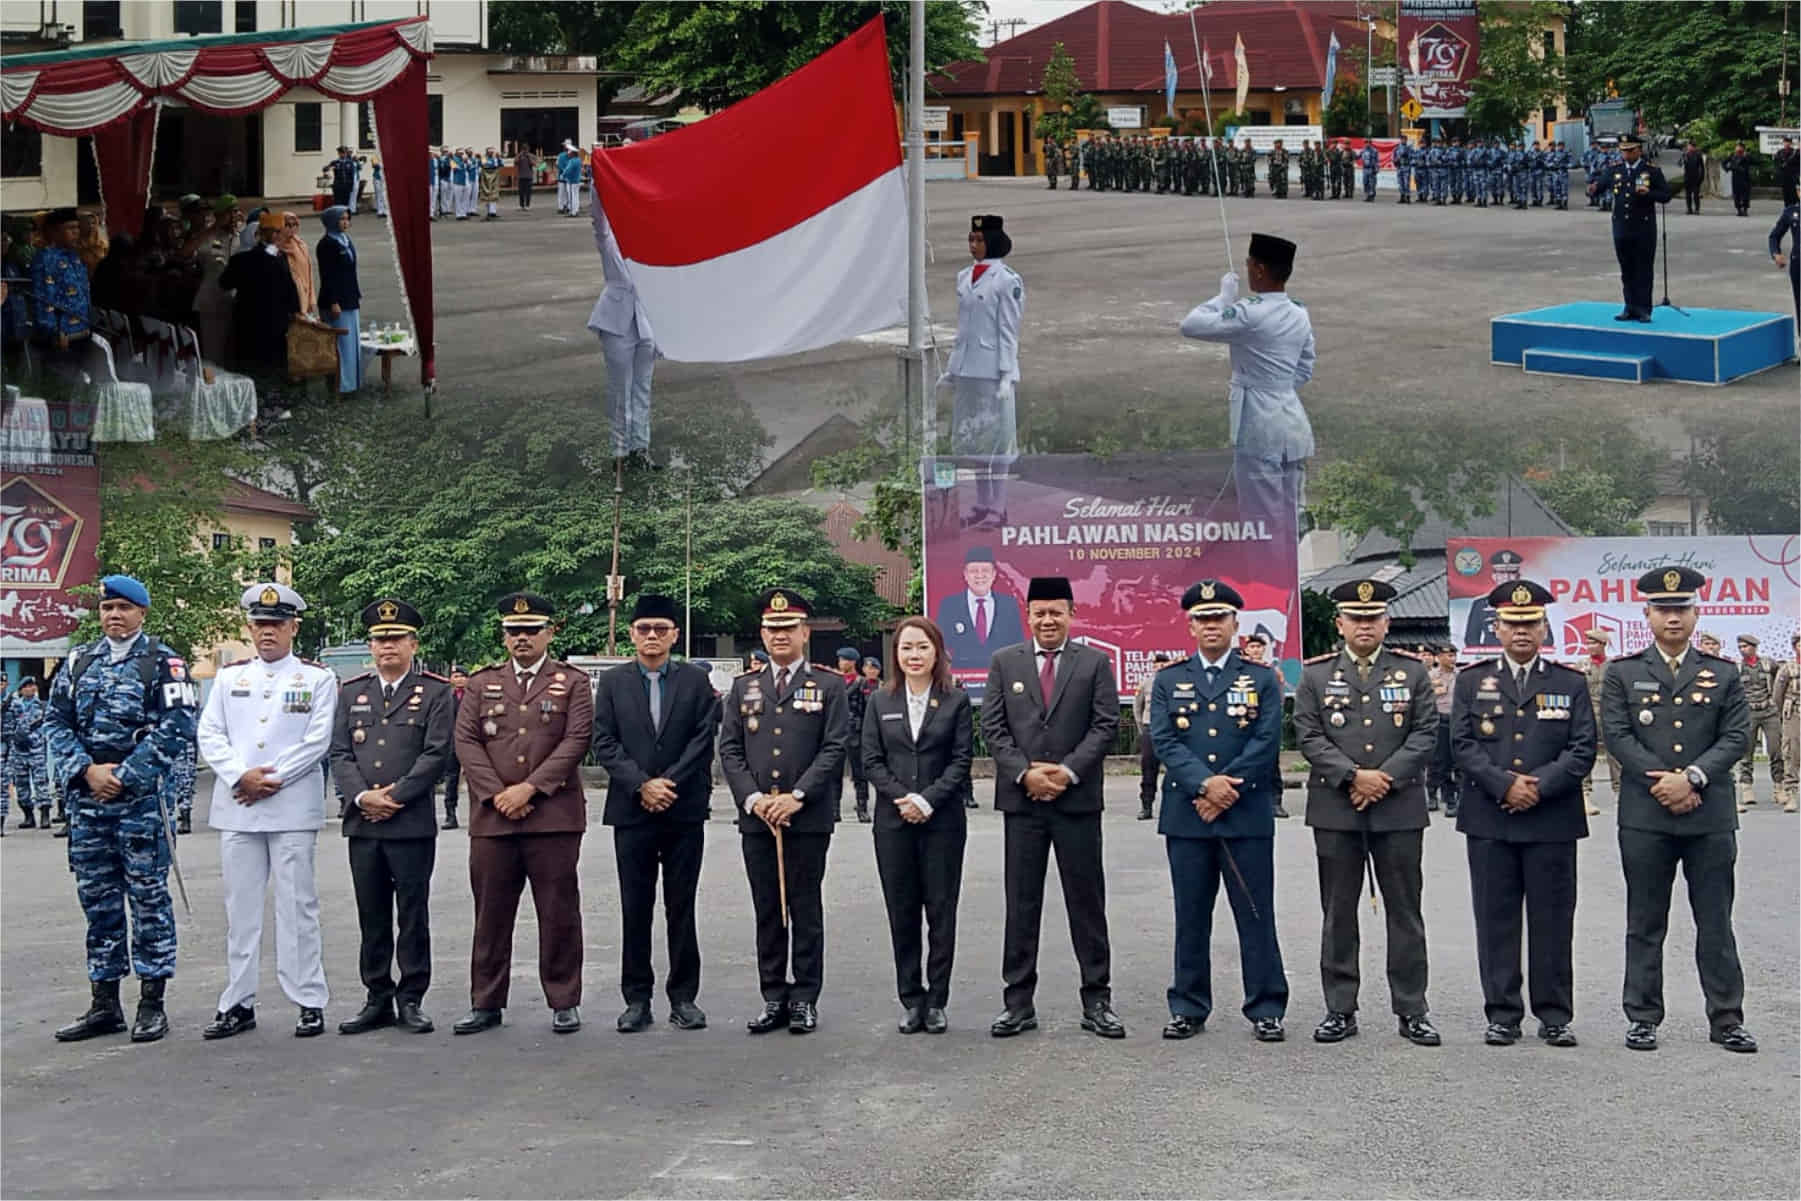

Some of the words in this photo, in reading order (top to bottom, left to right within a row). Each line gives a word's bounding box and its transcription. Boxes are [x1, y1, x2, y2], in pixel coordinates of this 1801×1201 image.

[1063, 497, 1142, 519] Selamat
[1146, 497, 1194, 517] Hari
[1001, 523, 1138, 546] PAHLAWAN
[1144, 520, 1273, 542] NASIONAL
[1068, 549, 1085, 561] 10
[1089, 547, 1161, 561] NOVEMBER
[1165, 546, 1202, 560] 2024
[1598, 551, 1671, 575] Selamat
[1549, 577, 1769, 602] PAHLAN
